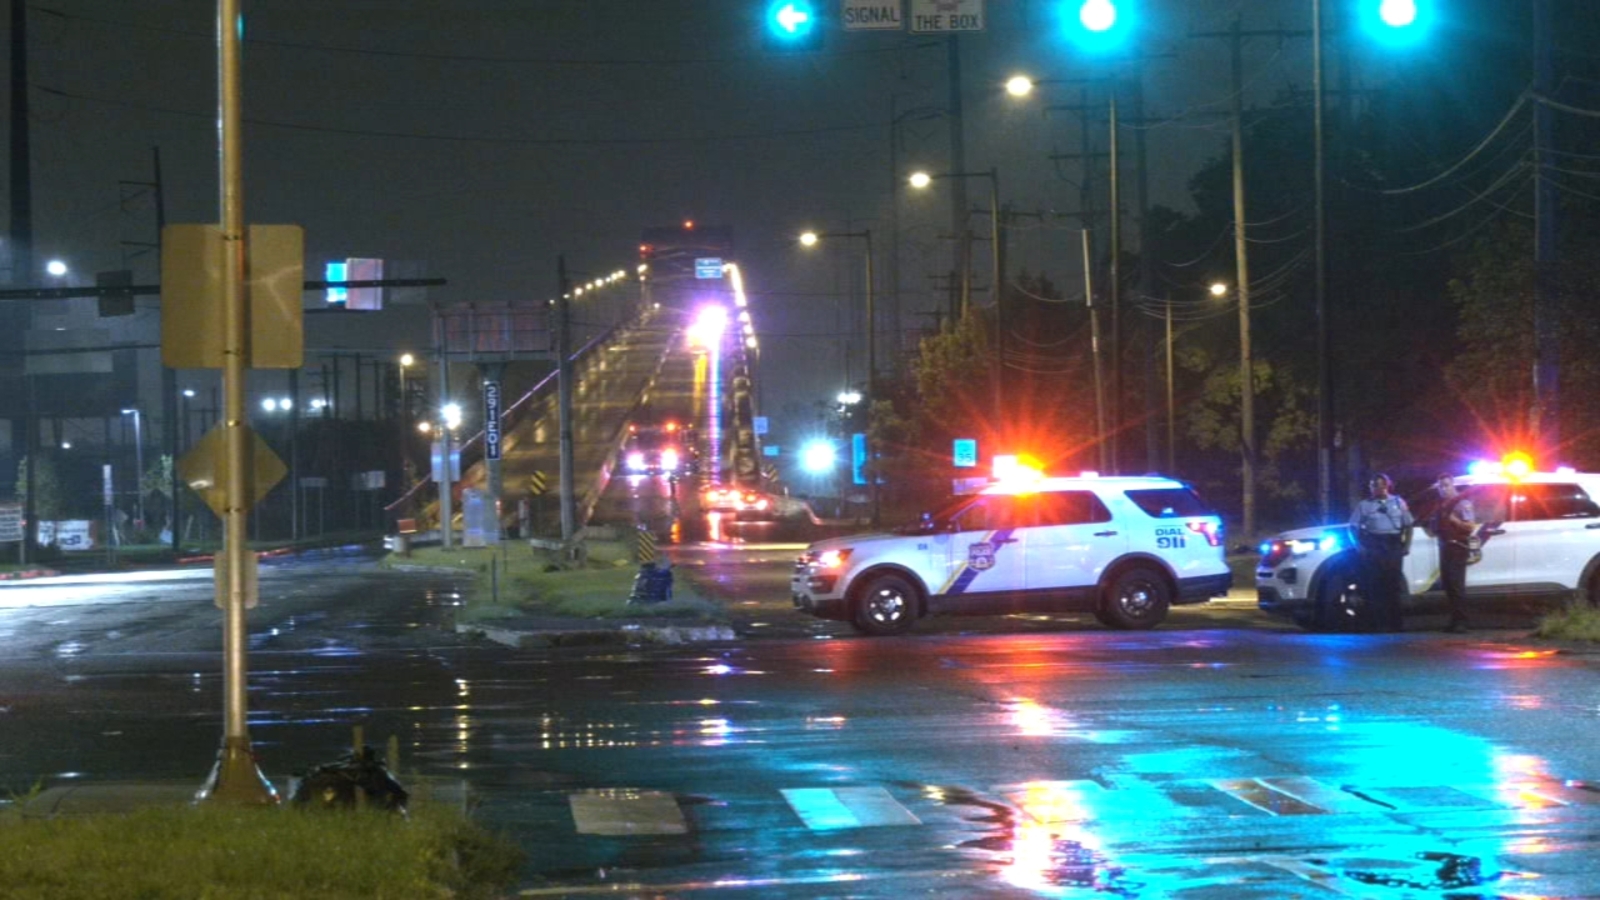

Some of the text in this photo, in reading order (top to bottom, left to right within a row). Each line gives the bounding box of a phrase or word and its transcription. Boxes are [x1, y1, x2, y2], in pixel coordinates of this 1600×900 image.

[845, 7, 899, 23] SIGNAL
[915, 14, 979, 29] THE BOX
[1155, 528, 1183, 536] DIAL
[1156, 536, 1186, 549] 911
